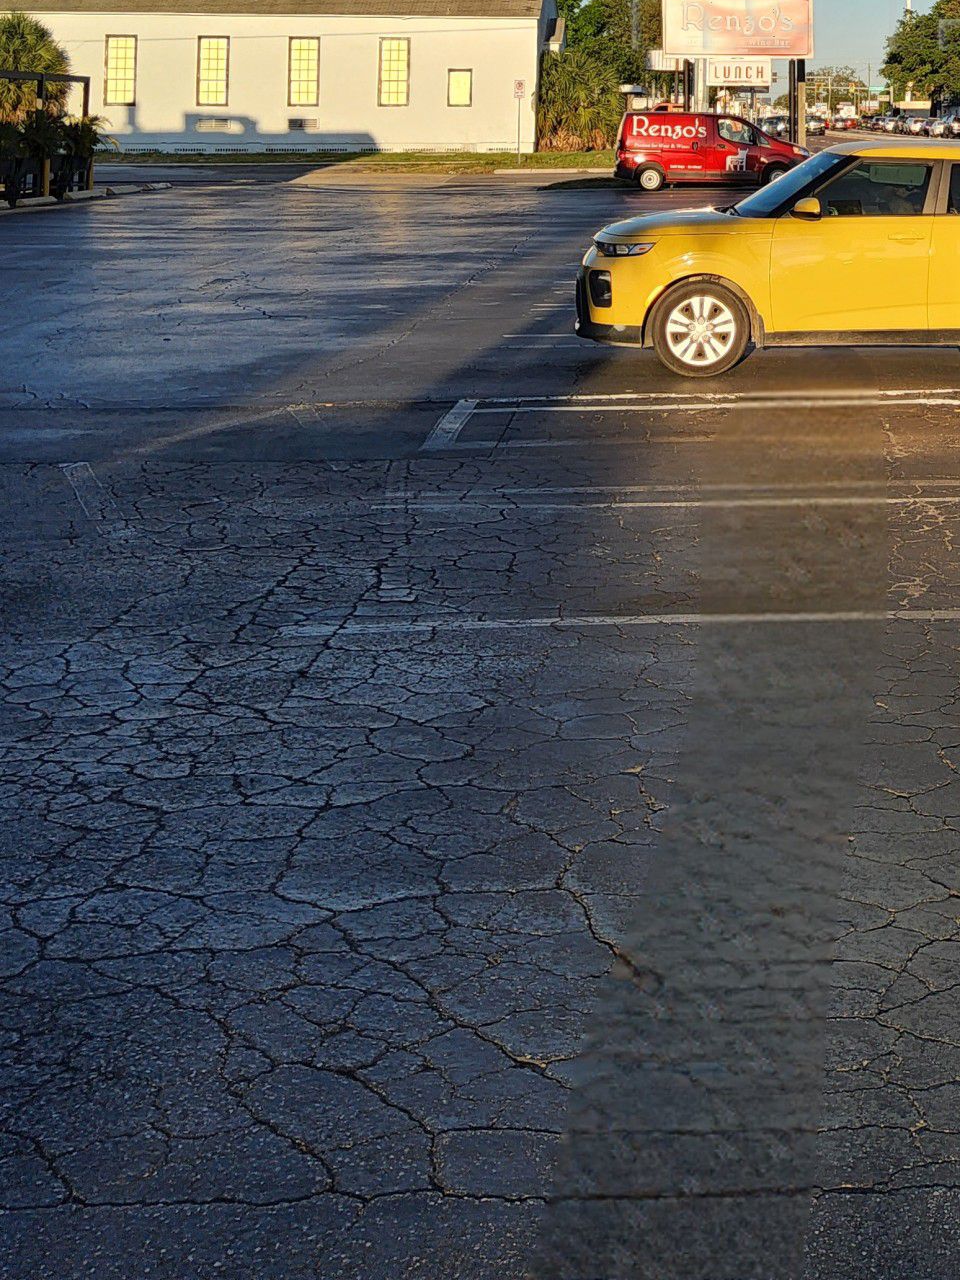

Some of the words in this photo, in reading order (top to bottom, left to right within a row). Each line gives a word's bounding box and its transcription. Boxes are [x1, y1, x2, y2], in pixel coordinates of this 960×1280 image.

[681, 2, 793, 35] Renzo's
[714, 65, 764, 79] LUNCH
[632, 115, 707, 139] Renzo's
